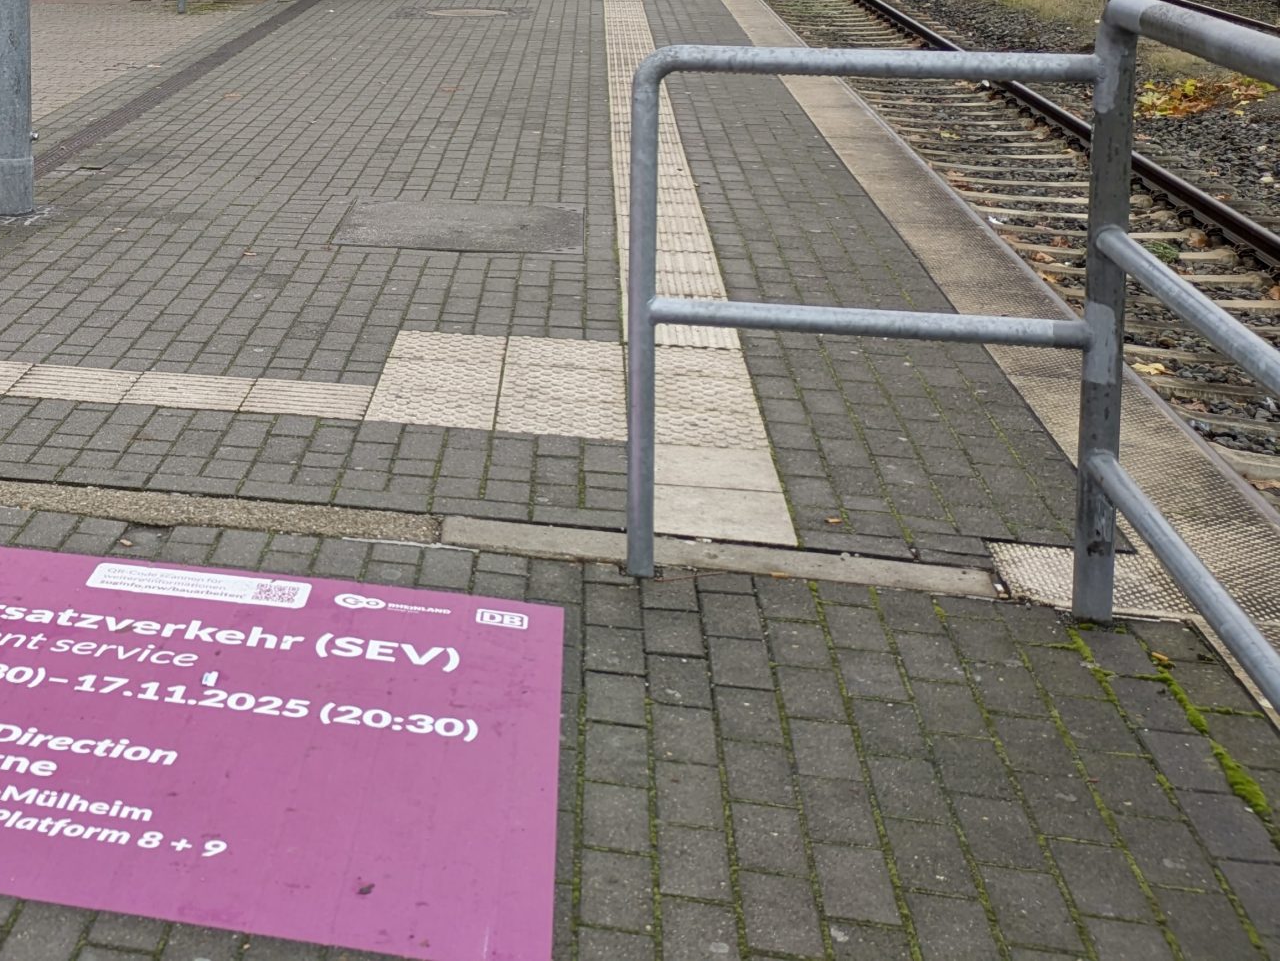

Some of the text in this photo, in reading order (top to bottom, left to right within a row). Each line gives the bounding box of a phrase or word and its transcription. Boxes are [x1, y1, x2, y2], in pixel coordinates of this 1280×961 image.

[481, 611, 524, 627] DB
[50, 636, 199, 667] service
[316, 633, 461, 672] (SEV)
[74, 673, 310, 719] 17.11.2025
[319, 702, 479, 742] (20:30)
[137, 831, 164, 849] 8
[170, 838, 192, 852] +
[201, 840, 227, 857] 9
